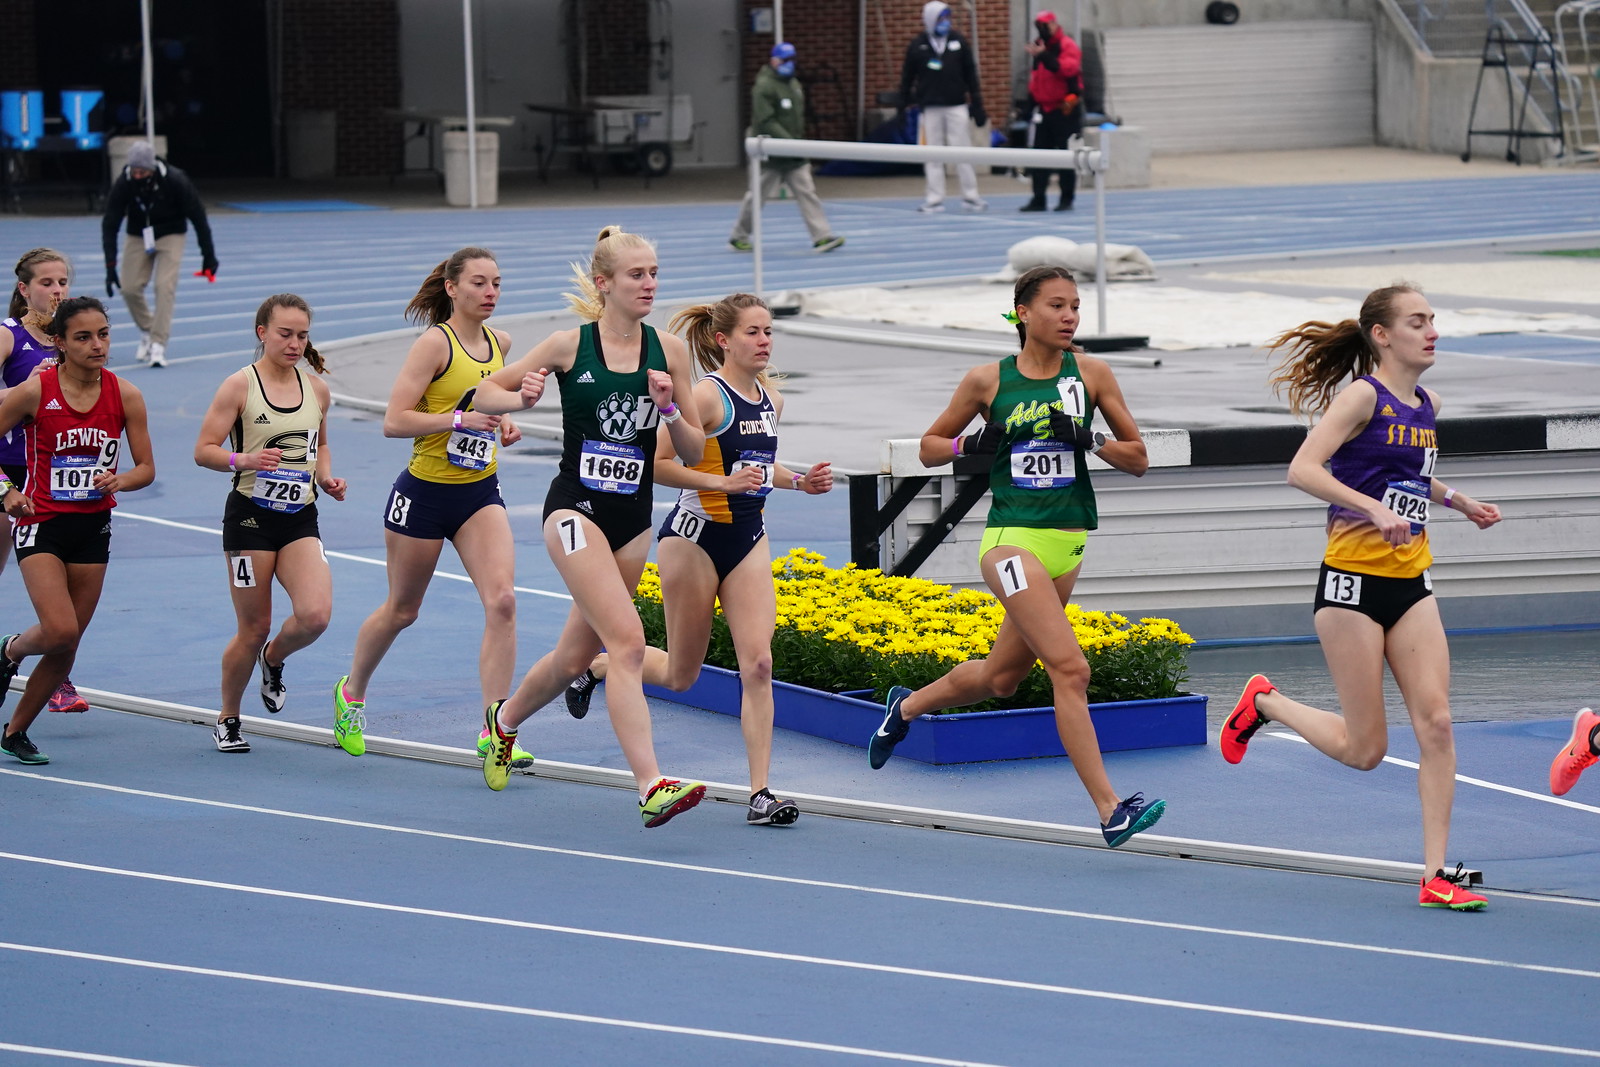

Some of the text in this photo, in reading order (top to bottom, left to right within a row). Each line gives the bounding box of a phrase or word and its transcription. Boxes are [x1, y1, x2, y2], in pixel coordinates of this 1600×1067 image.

[643, 398, 656, 428] 7
[1067, 384, 1081, 415] 1
[55, 427, 108, 451] LEWIS
[608, 418, 628, 437] N
[101, 439, 118, 467] 9
[310, 431, 318, 459] 4
[456, 437, 488, 459] 443
[585, 456, 640, 482] 1668
[1022, 454, 1062, 476] 201
[264, 480, 302, 502] 726
[392, 494, 406, 523] 8
[1388, 491, 1428, 522] 1929
[18, 525, 32, 547] 9
[561, 518, 576, 551] 7
[677, 512, 699, 539] 10
[237, 558, 251, 586] 4
[1004, 560, 1020, 591] 1
[1331, 574, 1355, 602] 13
